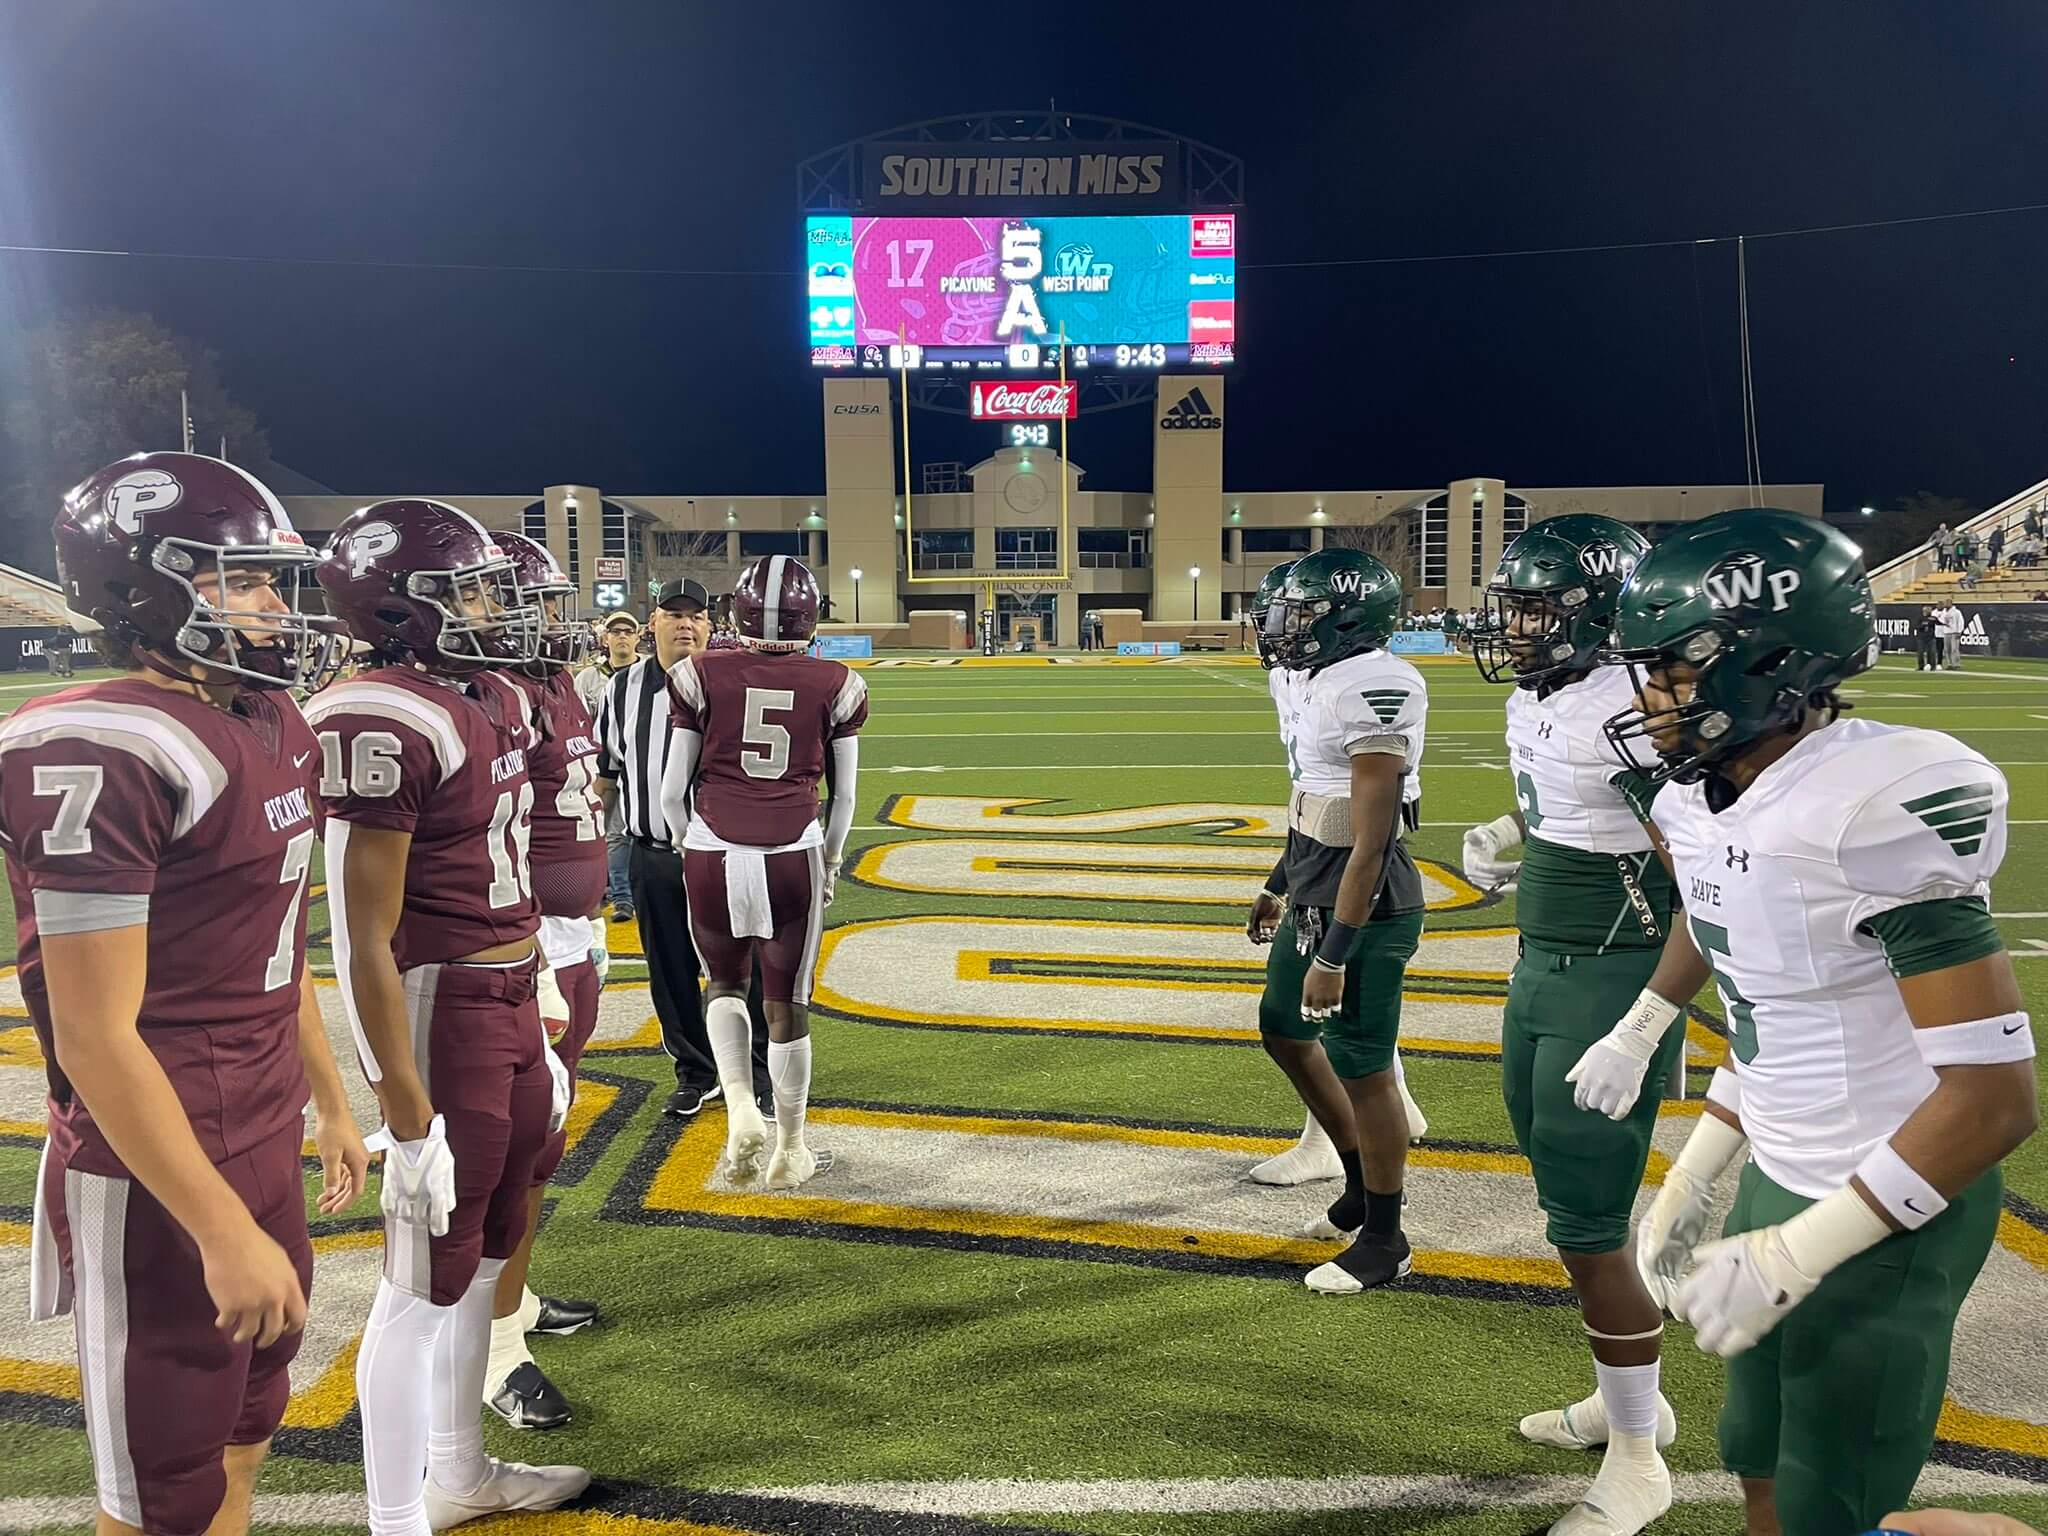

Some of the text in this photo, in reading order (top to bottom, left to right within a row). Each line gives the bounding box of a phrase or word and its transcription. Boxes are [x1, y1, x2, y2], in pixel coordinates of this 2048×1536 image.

[880, 154, 1163, 195] SOUTHERN MISS
[886, 240, 933, 287] 17
[940, 276, 996, 292] PICAYUNE
[1043, 276, 1110, 292] WEST POINT
[1076, 345, 1086, 360] 0
[1115, 344, 1166, 366] 9:43
[986, 385, 1074, 414] Coca-Cola
[1012, 424, 1048, 445] 9:43
[1161, 415, 1222, 430] adidas
[597, 584, 625, 607] 25
[980, 581, 1027, 591] AHLETIC
[1032, 581, 1073, 590] CENTER
[1335, 574, 1377, 600] WP
[1707, 559, 1801, 613] WP
[749, 640, 794, 651] Riddell
[1960, 634, 1990, 646] adidas
[740, 687, 795, 780] 5
[319, 730, 403, 798] 16
[33, 765, 104, 856] 7
[1517, 769, 1545, 831] 2
[1690, 876, 1722, 907] WAVE
[265, 827, 315, 992] 7
[1690, 913, 1761, 1065] 5
